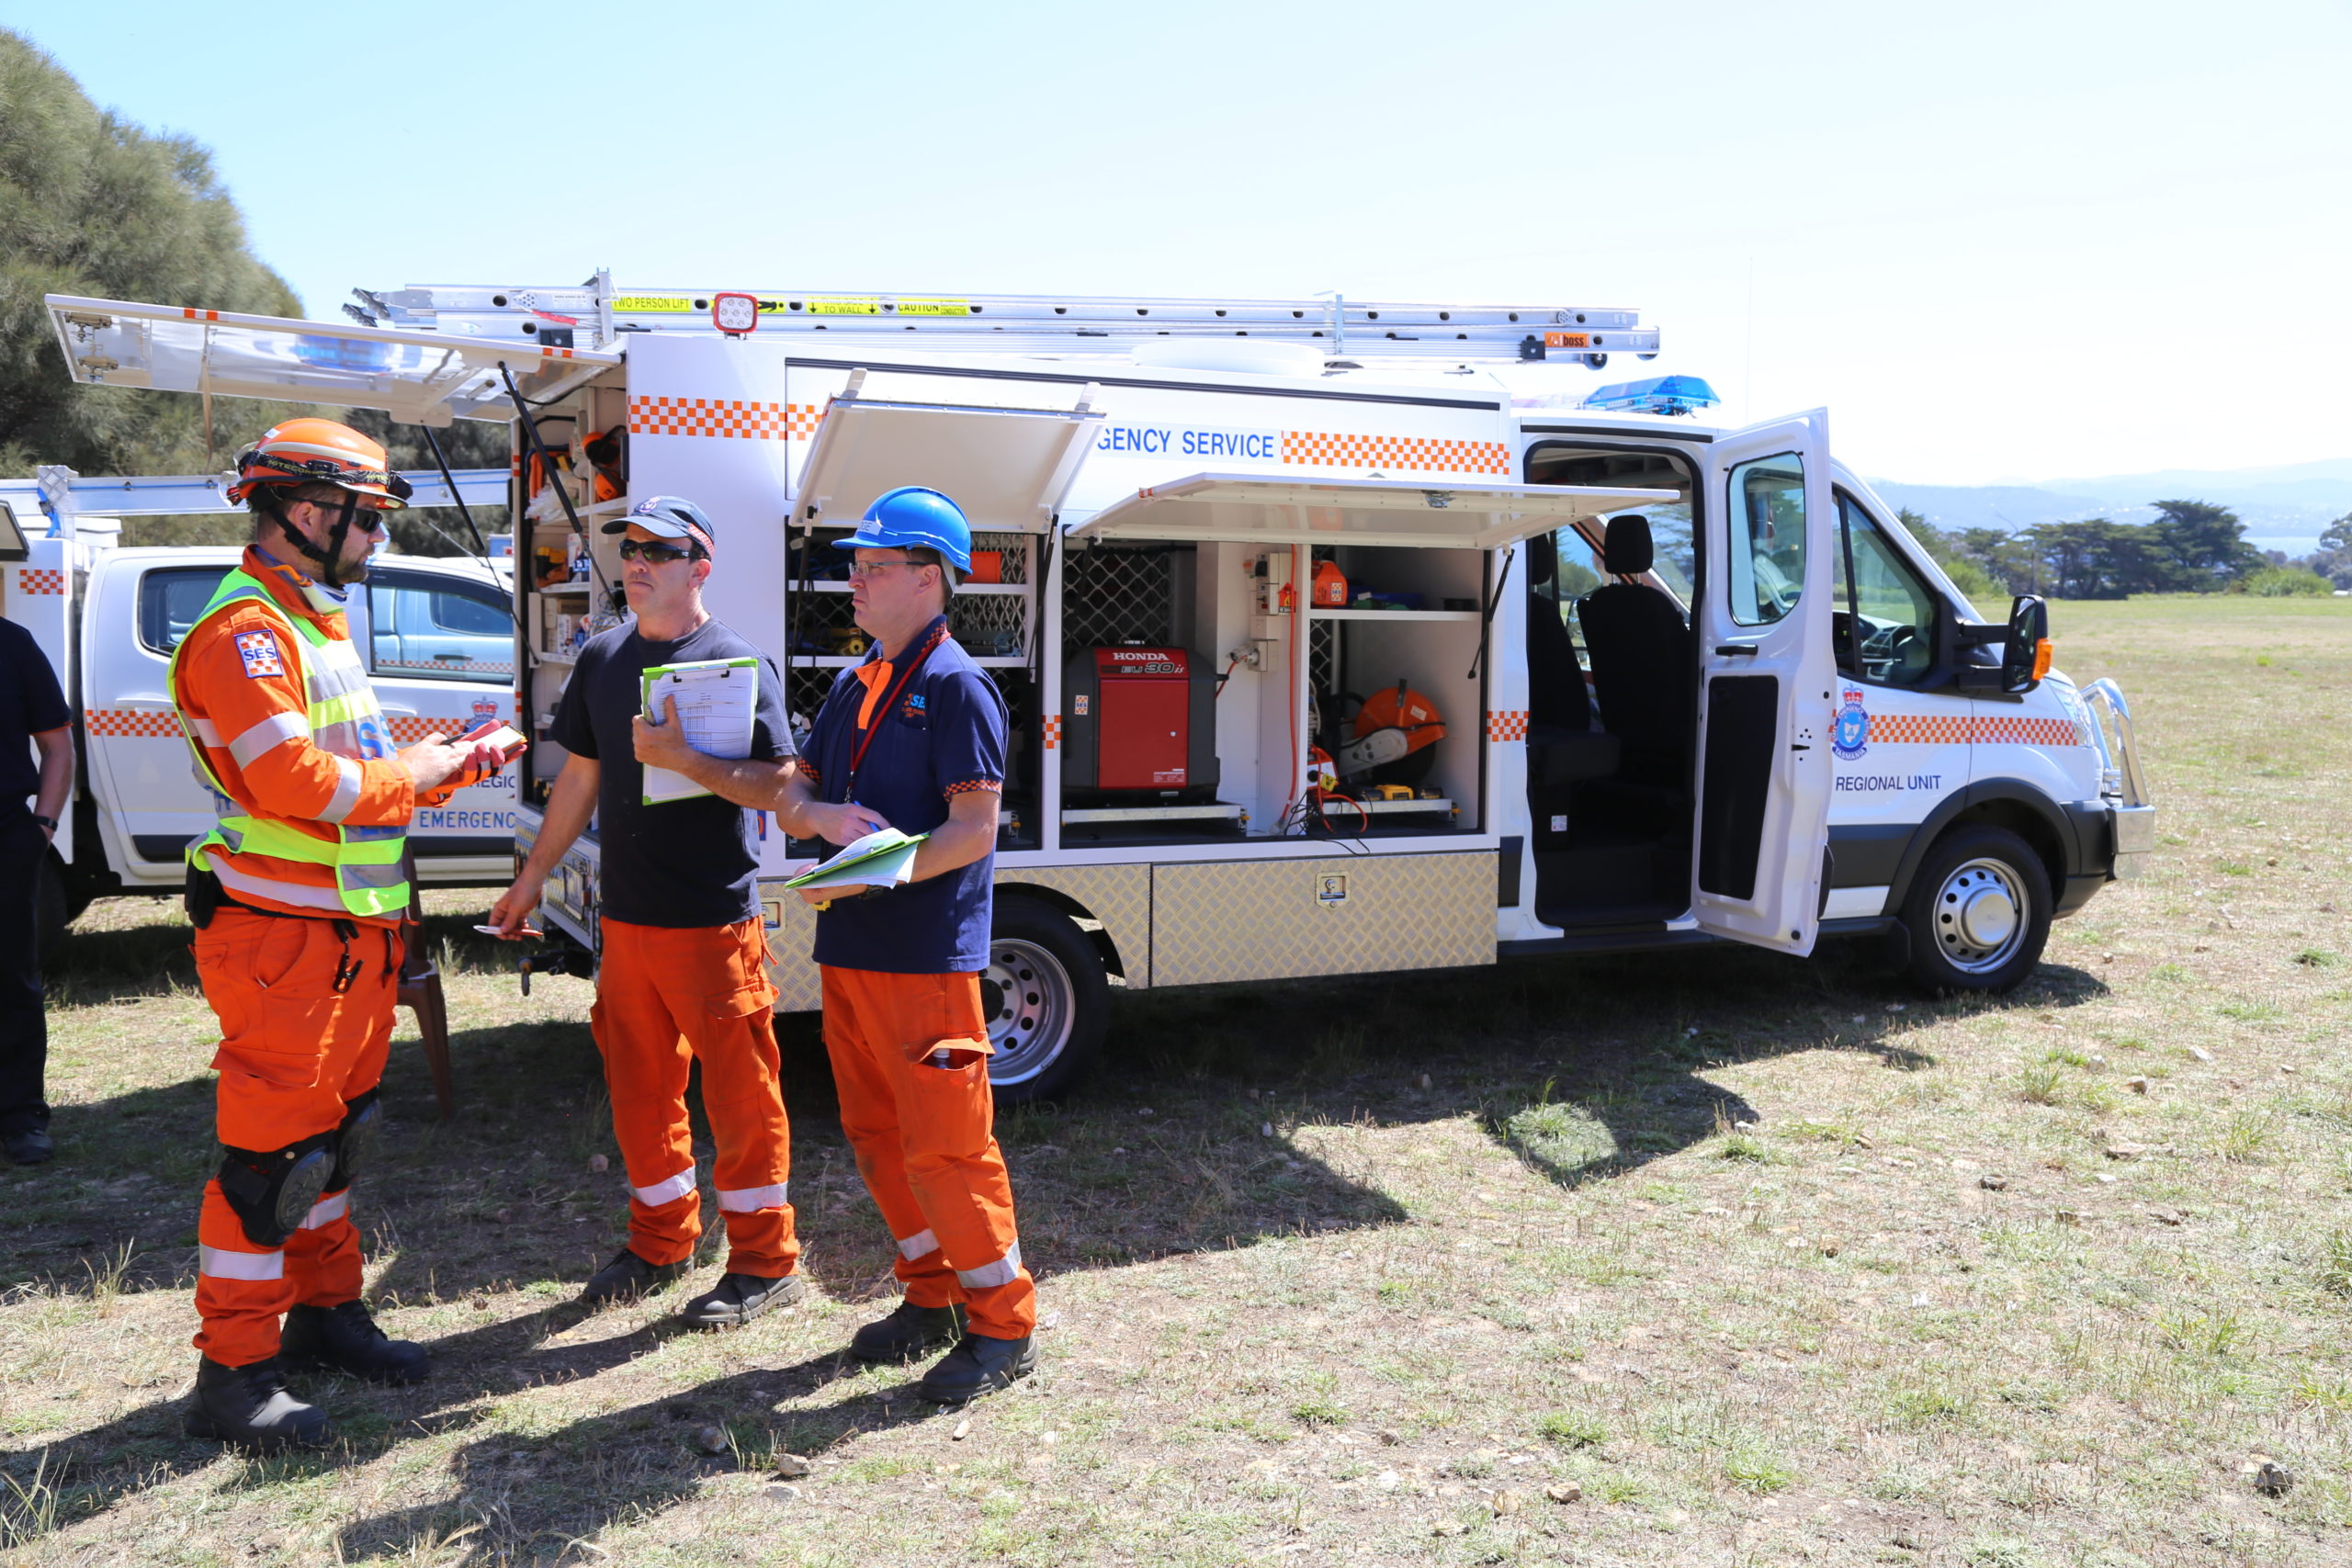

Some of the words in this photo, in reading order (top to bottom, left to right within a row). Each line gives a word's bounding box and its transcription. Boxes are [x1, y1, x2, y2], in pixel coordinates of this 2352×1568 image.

[635, 297, 671, 309] PERSON
[673, 298, 689, 309] LIFT
[898, 302, 939, 312] CAUTION
[838, 306, 863, 314] WALL
[1563, 334, 1584, 346] boss
[1182, 430, 1274, 458] SERVICE
[243, 648, 277, 660] SES
[1113, 652, 1169, 660] HONDA
[1836, 775, 1905, 791] REGIONAL
[1907, 774, 1941, 790] UNIT
